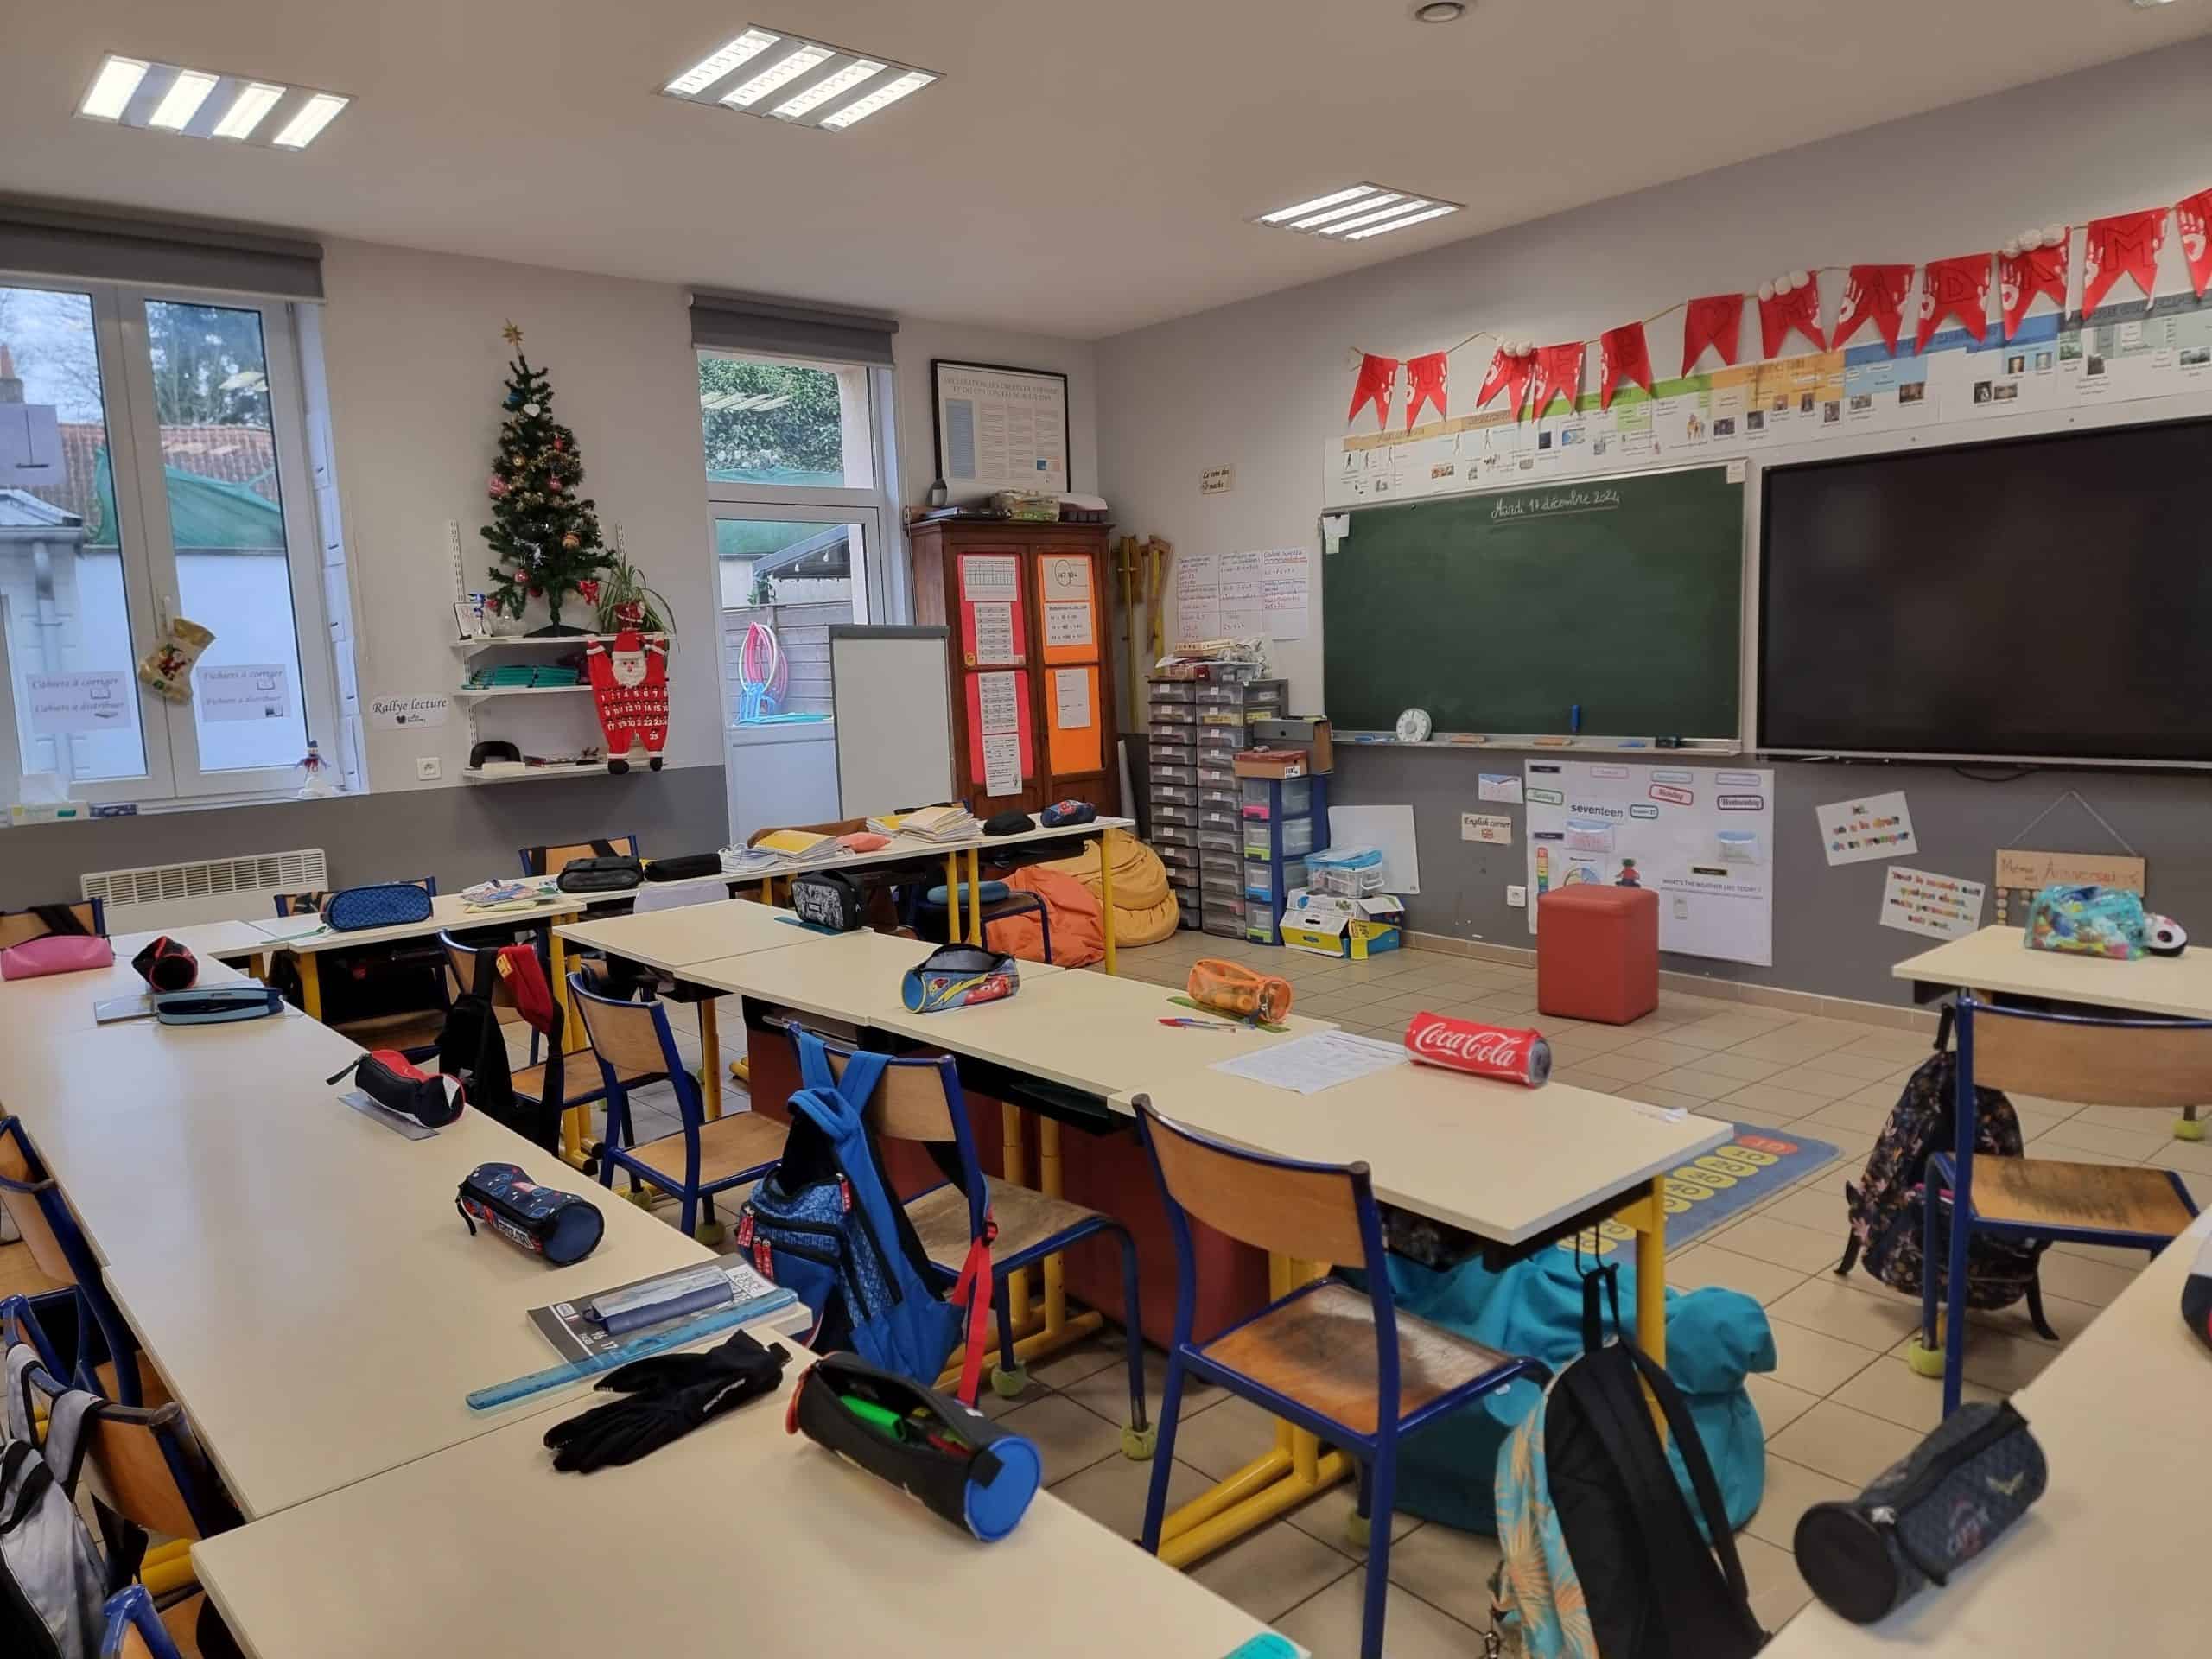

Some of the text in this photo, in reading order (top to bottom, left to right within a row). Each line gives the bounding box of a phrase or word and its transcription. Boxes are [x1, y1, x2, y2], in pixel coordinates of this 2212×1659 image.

[1491, 498, 1525, 518] Mardi
[1527, 499, 1541, 512] 17
[1541, 489, 1591, 511] décembre
[373, 698, 447, 715] Rallye lecture
[1570, 804, 1624, 818] seventeen
[1465, 817, 1487, 828] English
[1731, 1149, 1765, 1162] 10
[1710, 1160, 1745, 1173] 20
[1688, 1171, 1724, 1185] 30
[1668, 1182, 1702, 1196] 40
